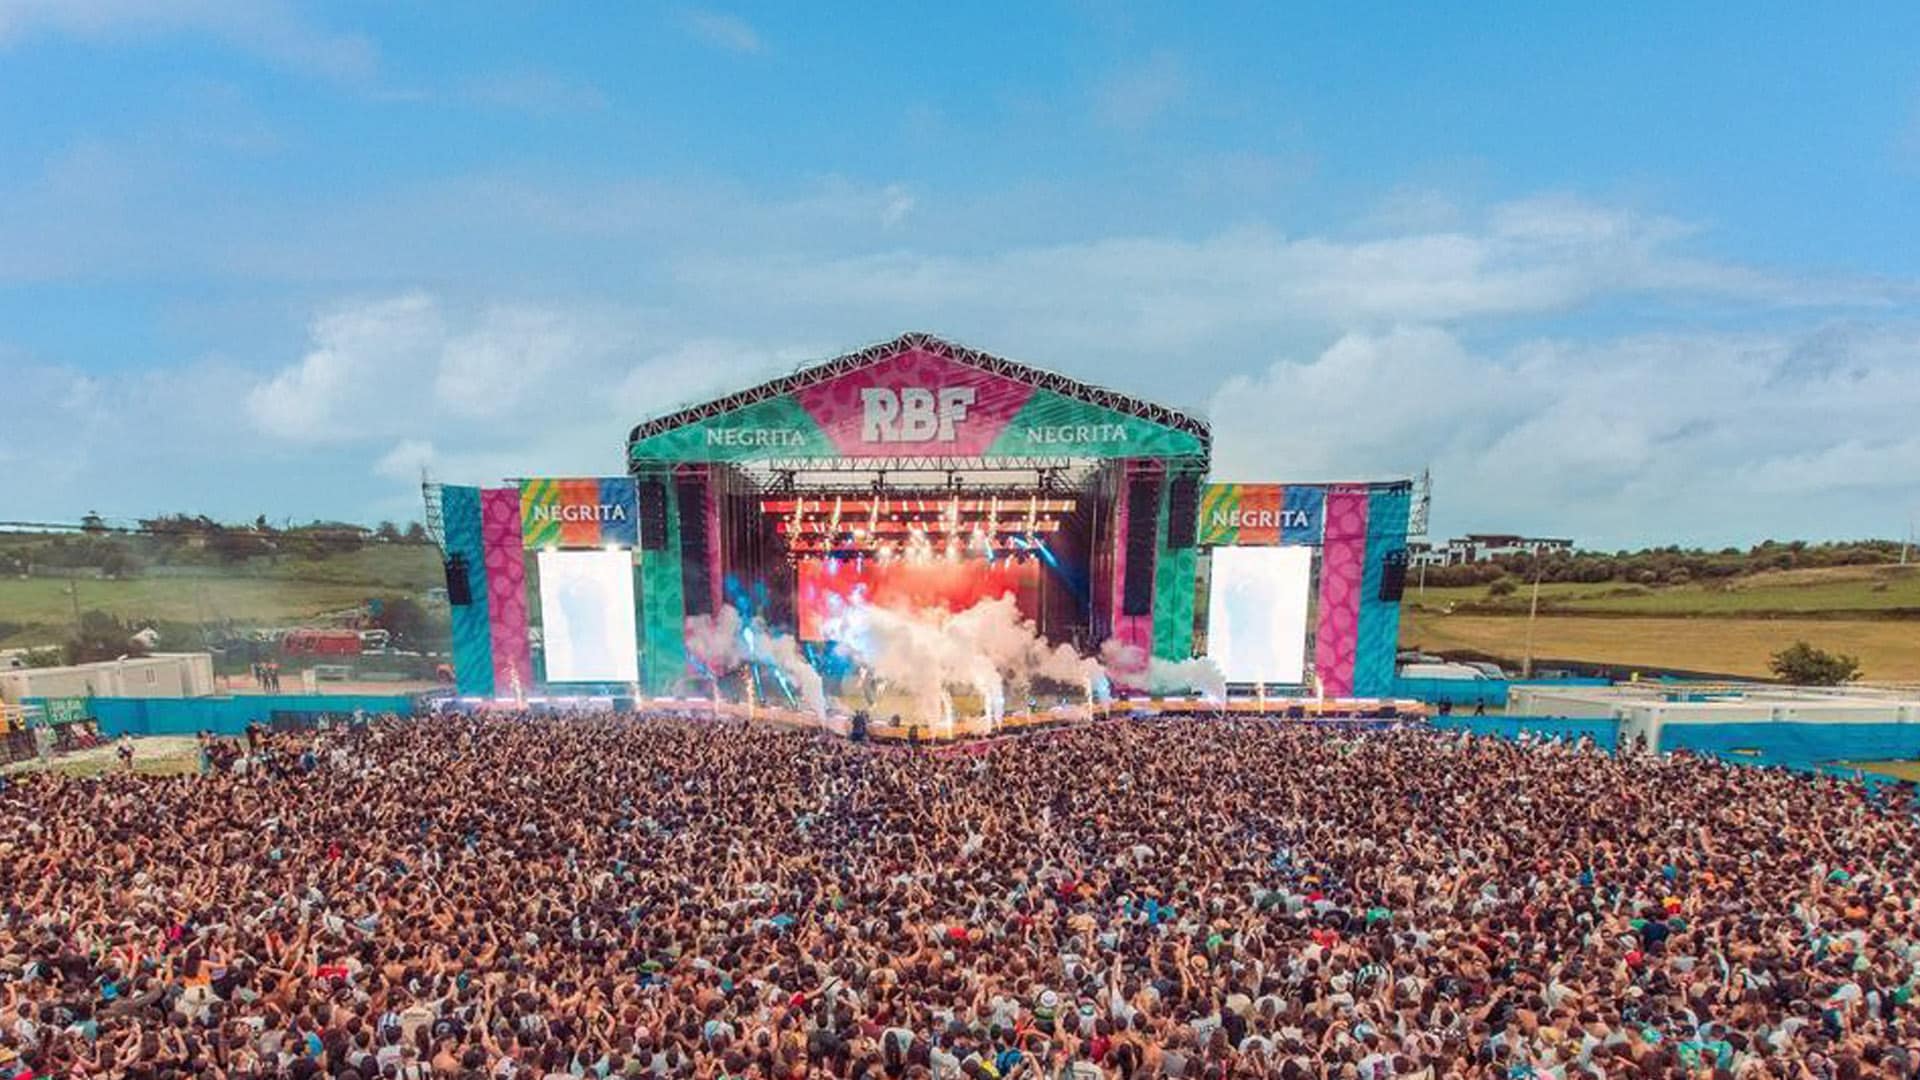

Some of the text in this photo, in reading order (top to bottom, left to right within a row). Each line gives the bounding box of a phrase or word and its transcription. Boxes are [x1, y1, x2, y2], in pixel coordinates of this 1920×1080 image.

[861, 386, 976, 443] RBF
[706, 428, 805, 446] NEGRITA
[1026, 423, 1128, 444] NEGRITA
[533, 503, 626, 521] NEGRITA
[1212, 509, 1309, 527] NEGRITA
